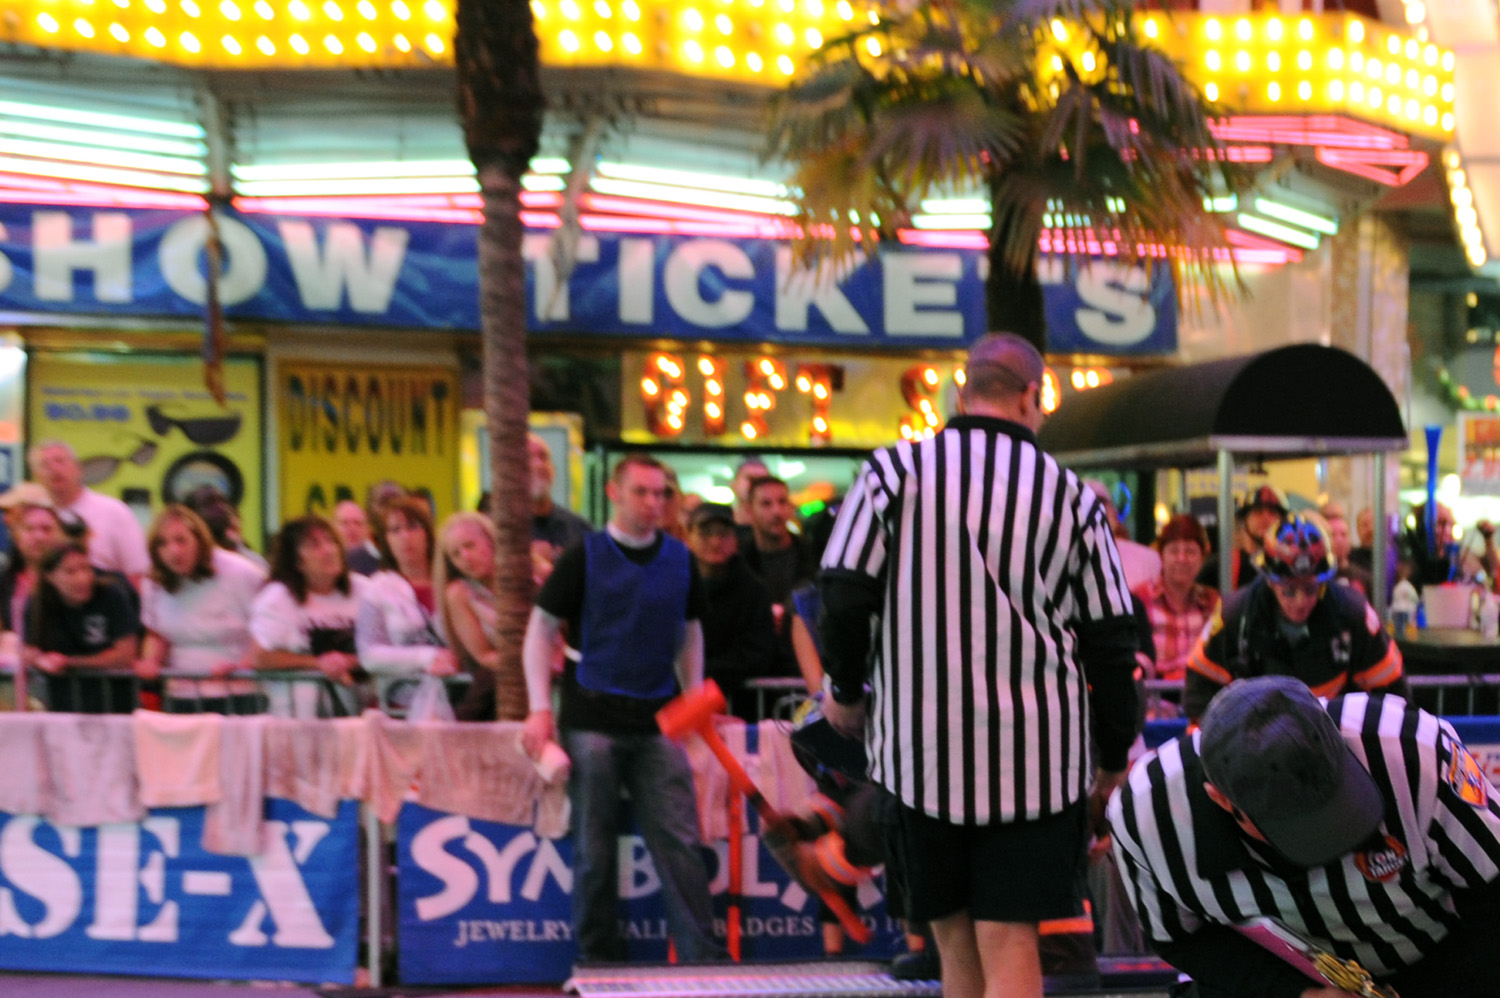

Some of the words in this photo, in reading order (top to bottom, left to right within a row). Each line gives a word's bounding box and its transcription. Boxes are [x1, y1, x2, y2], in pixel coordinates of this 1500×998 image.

[0, 211, 409, 314] HOW
[288, 373, 448, 454] DISCOUNT
[641, 354, 844, 439] GIFT
